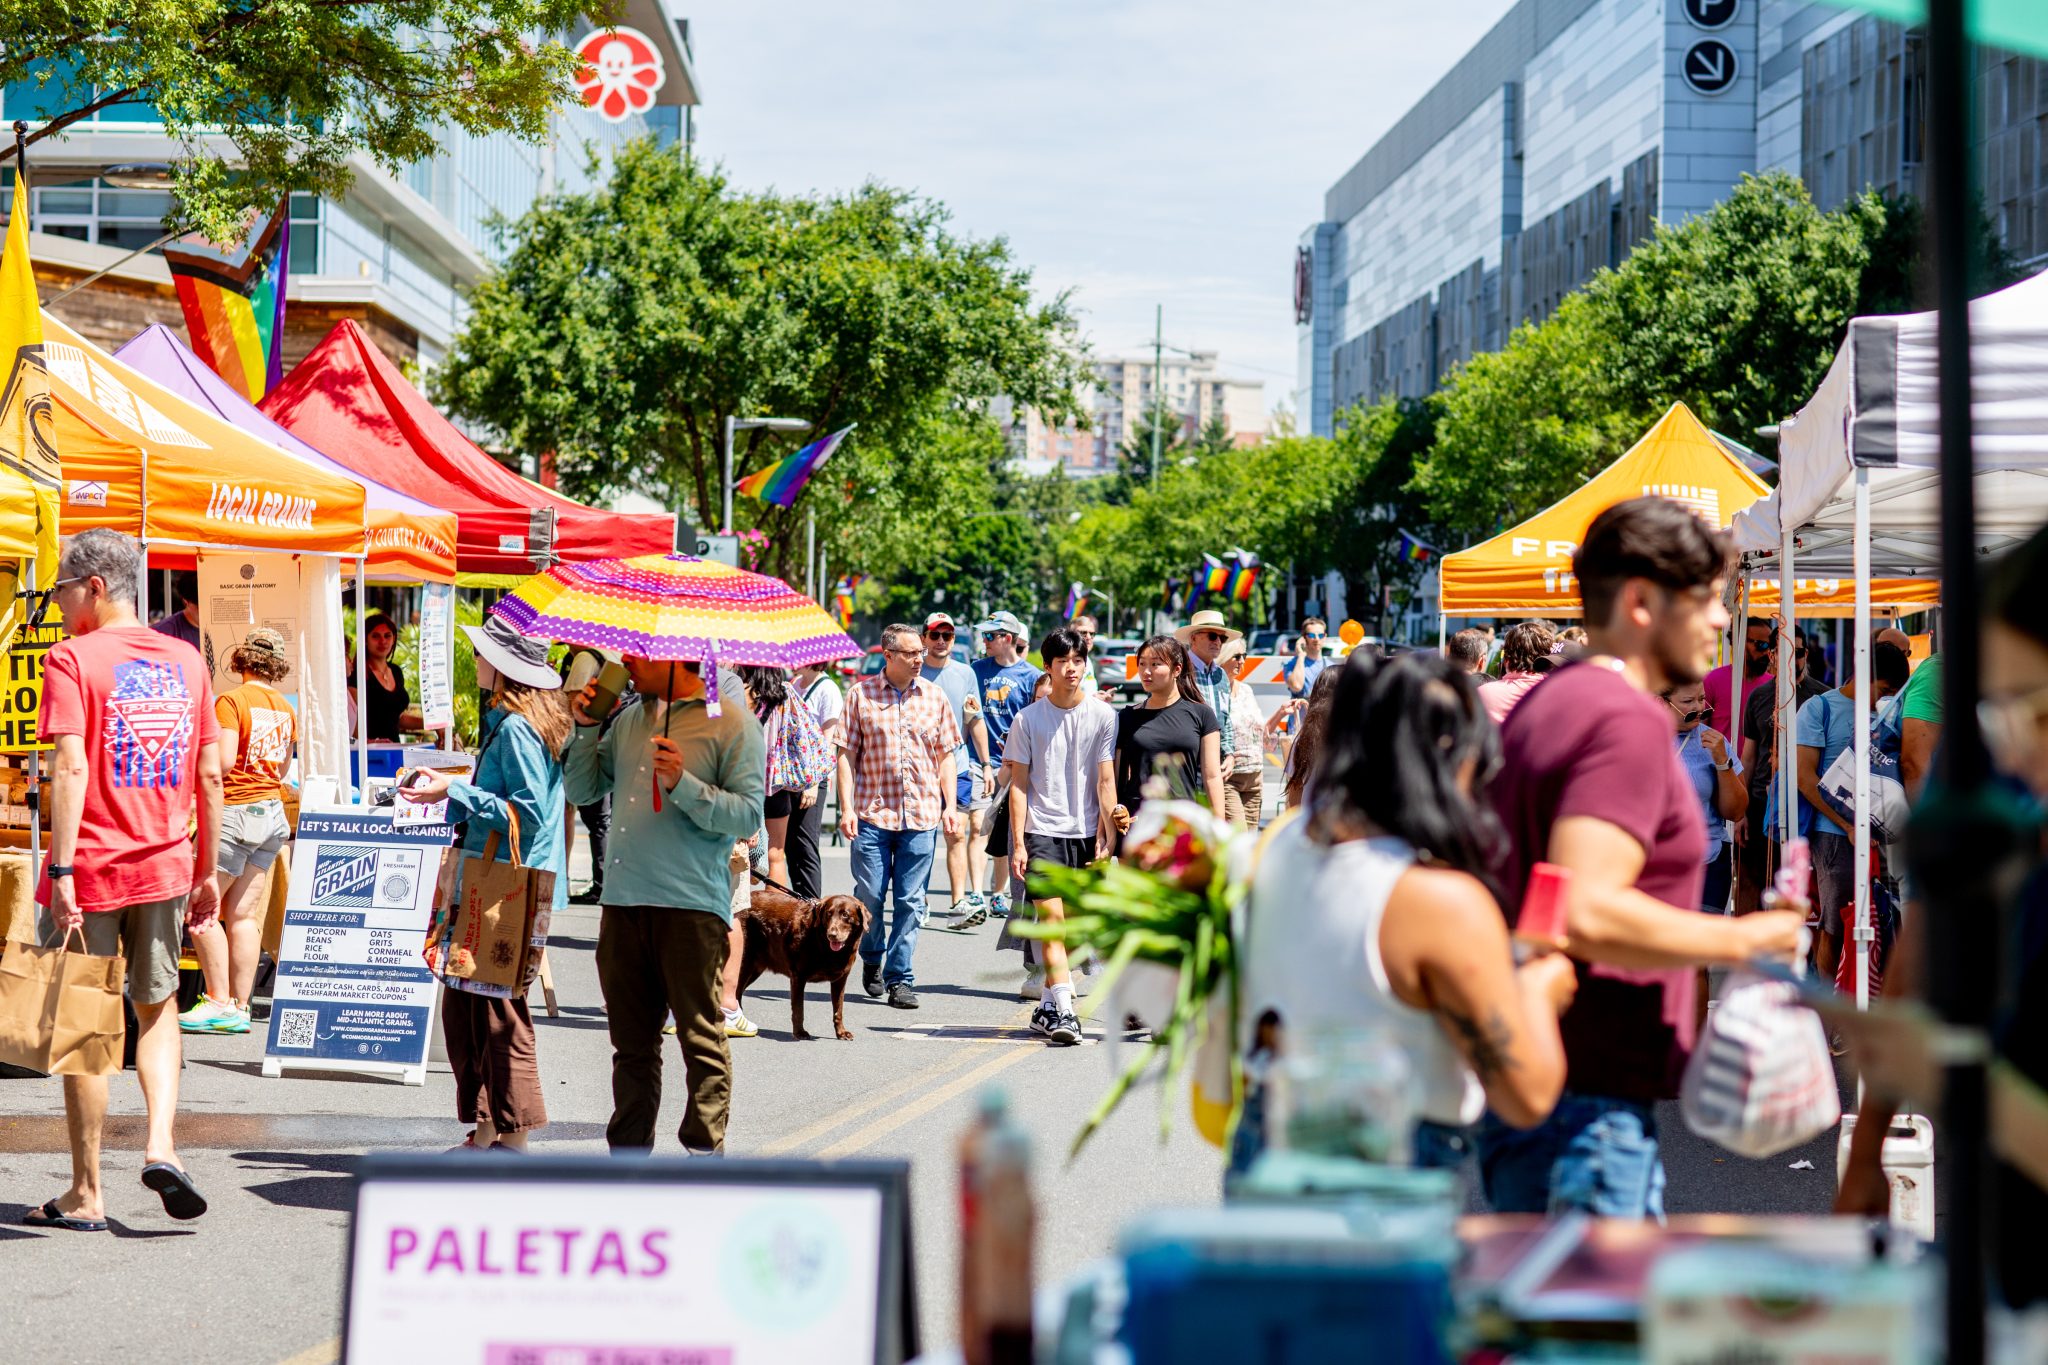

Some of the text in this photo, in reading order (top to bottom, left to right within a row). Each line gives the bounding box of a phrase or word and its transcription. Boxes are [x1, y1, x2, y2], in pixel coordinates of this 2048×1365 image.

[206, 482, 317, 531] LOCAL GRAINS
[375, 527, 414, 548] COUNTRY
[416, 531, 450, 556] SALMON
[697, 542, 707, 554] P
[12, 627, 63, 644] SAM
[1001, 676, 1018, 688] STOP
[300, 820, 450, 838] LET'S TALK LOCAL GRAINS!
[316, 858, 346, 877] ATLANTIC
[314, 852, 377, 899] GRAIN
[351, 876, 375, 894] STAND
[289, 912, 359, 923] SHOP HERE FOR:
[307, 928, 347, 936] POPCORN
[458, 887, 477, 966] TRADER JOE'S
[306, 936, 332, 944] BEANS
[369, 939, 392, 947] GRITS
[303, 953, 329, 961] FLOUR
[368, 948, 413, 957] CORNMEAL
[375, 957, 401, 965] MORE!
[290, 965, 303, 973] from
[304, 982, 332, 990] ACCEPT
[340, 991, 369, 999] MARKET
[371, 993, 407, 1001] COUPONS
[342, 1009, 409, 1019] LEARN MORE ABOUT
[337, 1016, 414, 1027] MID-ATLANTIC GRAINS:
[386, 1226, 670, 1278] PALETAS
